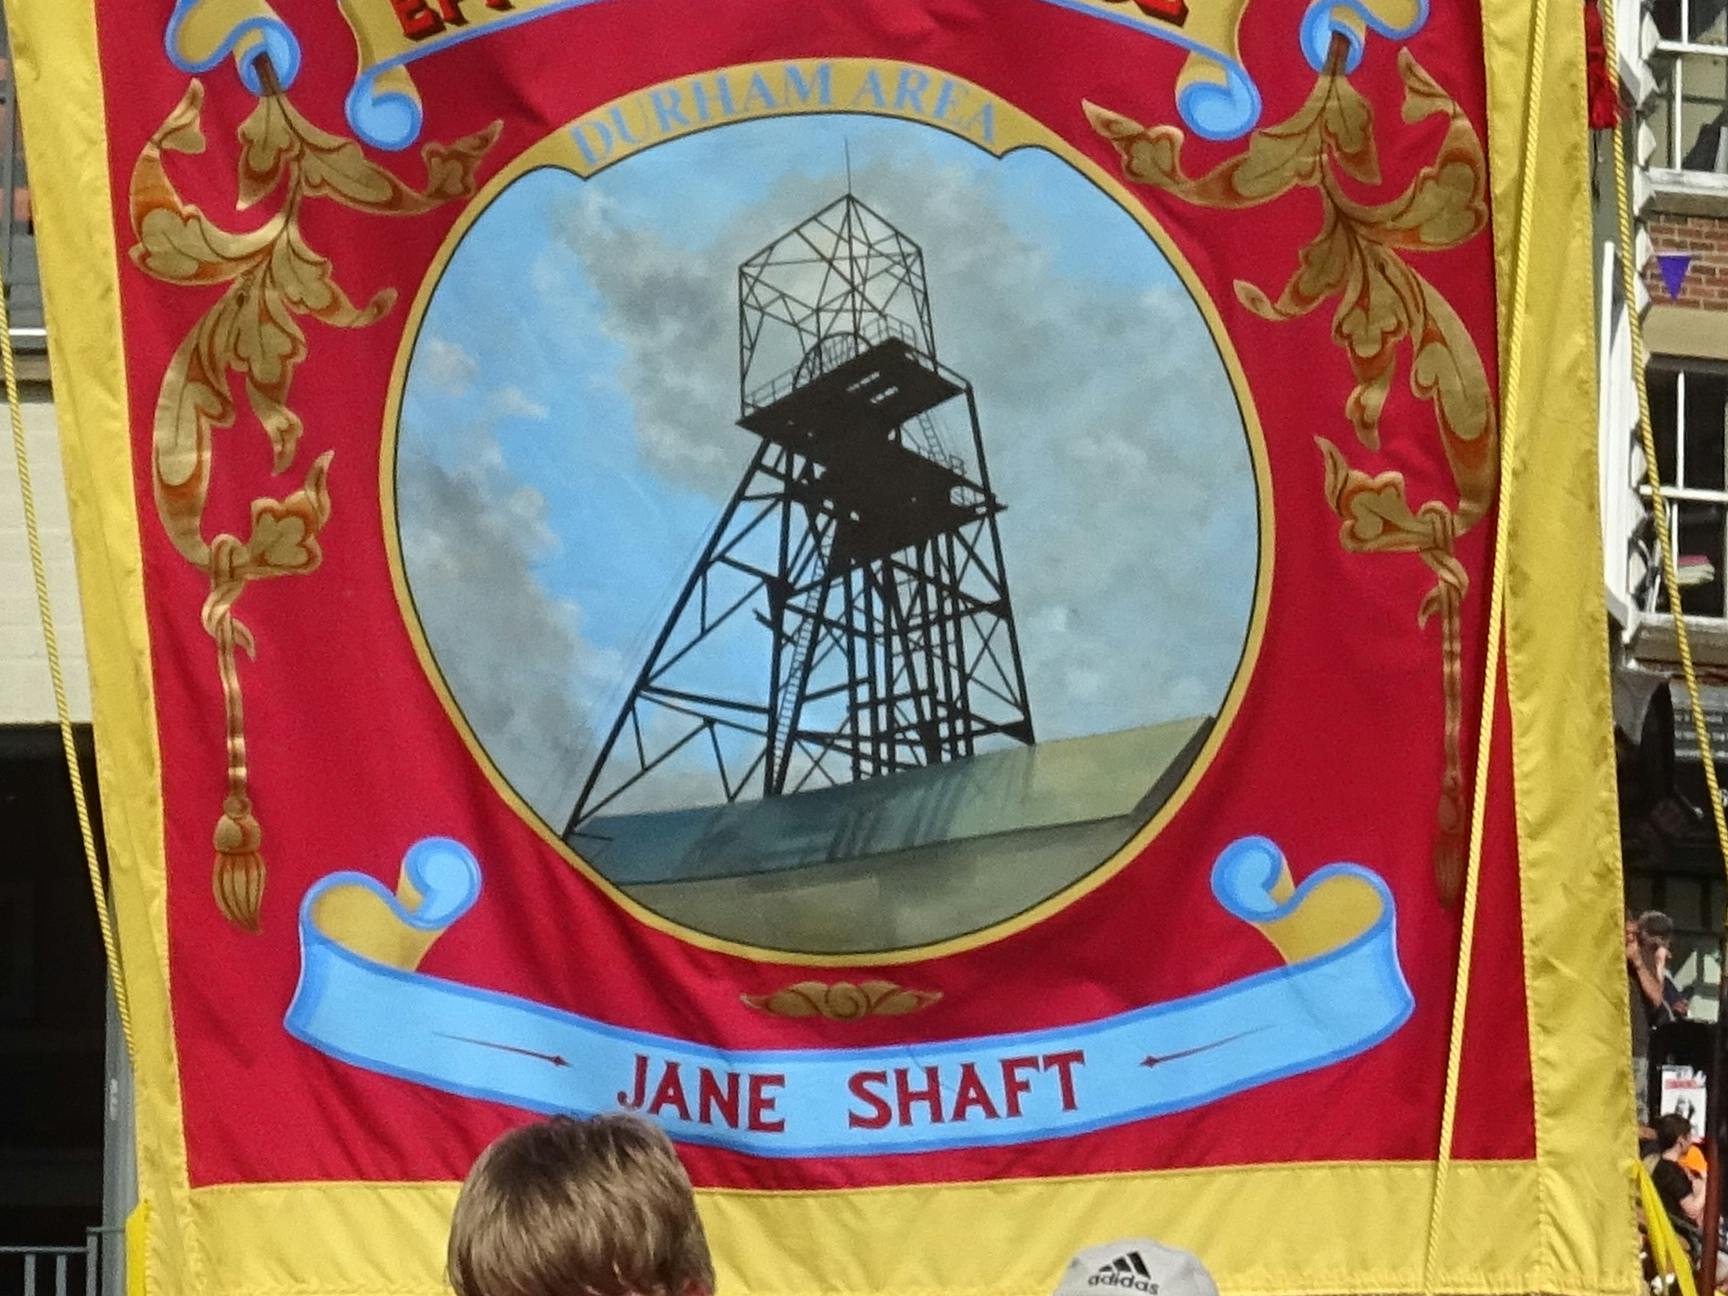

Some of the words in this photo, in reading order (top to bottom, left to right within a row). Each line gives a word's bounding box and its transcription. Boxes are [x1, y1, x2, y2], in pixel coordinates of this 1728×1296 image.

[572, 63, 832, 167] DURHAM
[855, 67, 998, 144] AREA
[617, 1053, 786, 1133] JANE
[848, 1049, 1086, 1130] SHAFT
[1088, 1271, 1160, 1296] adidas
